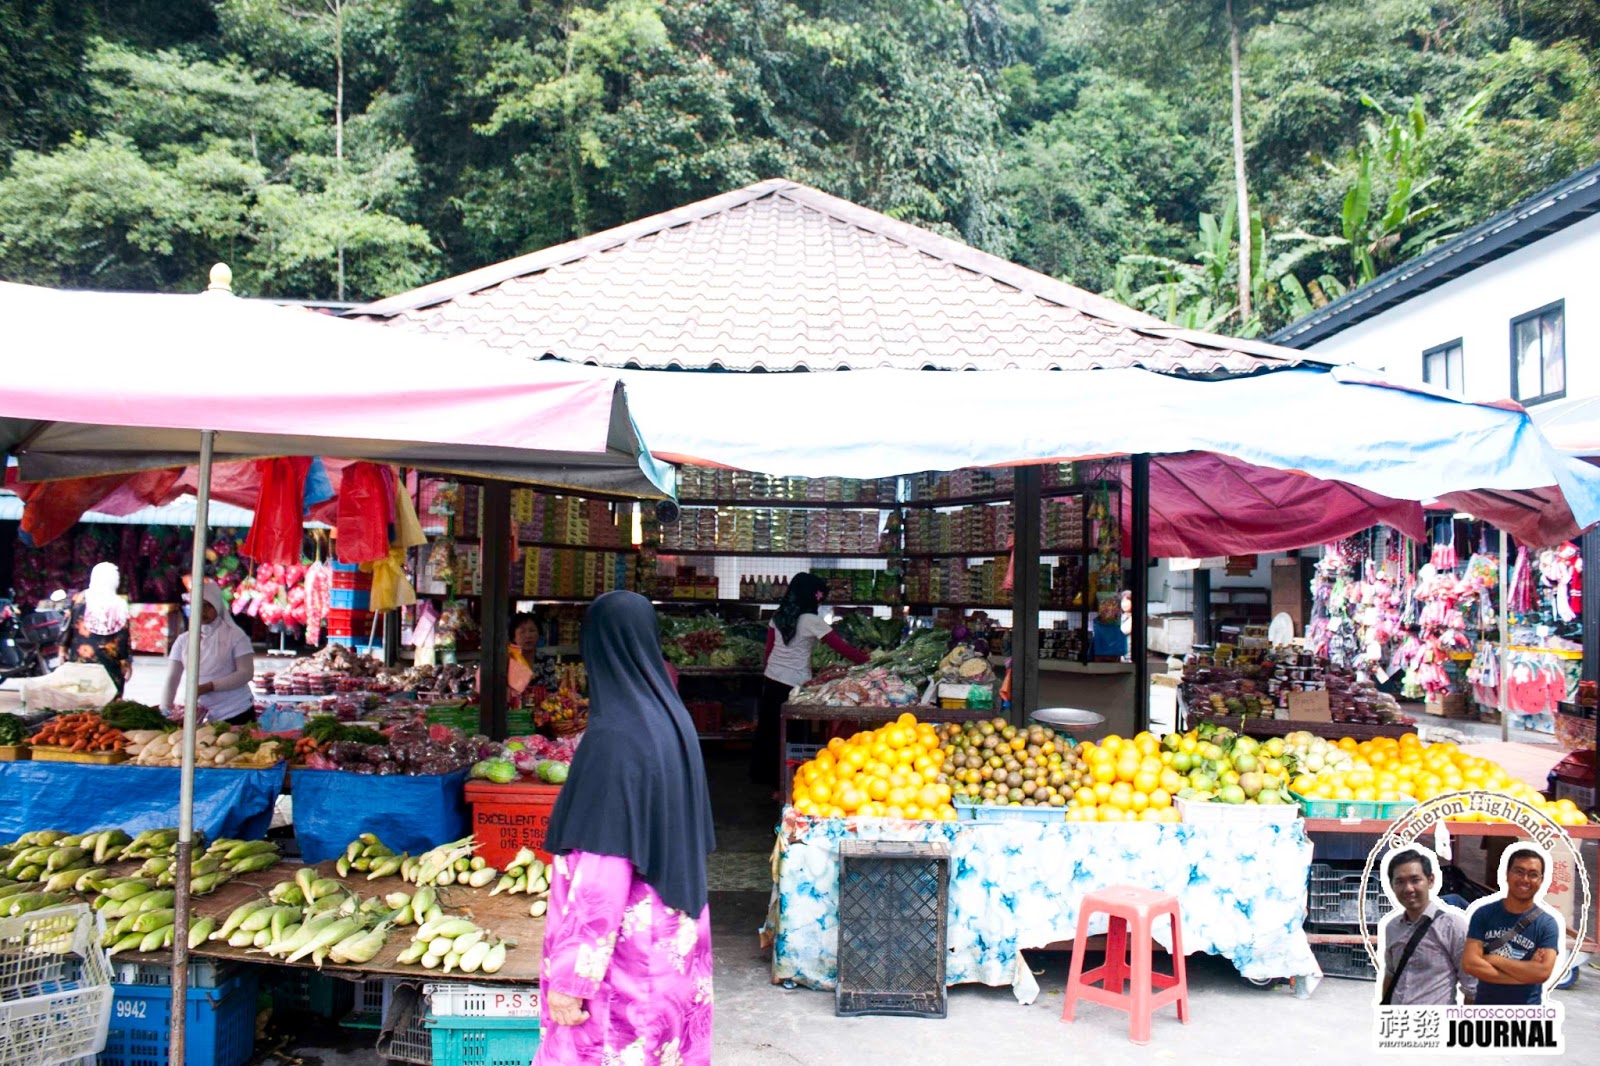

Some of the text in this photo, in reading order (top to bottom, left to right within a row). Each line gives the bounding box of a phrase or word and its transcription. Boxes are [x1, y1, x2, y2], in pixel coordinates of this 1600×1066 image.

[478, 813, 536, 825] EXCELLENT
[500, 828, 518, 838] 013
[495, 993, 522, 1008] P.S
[116, 1000, 147, 1018] 9942
